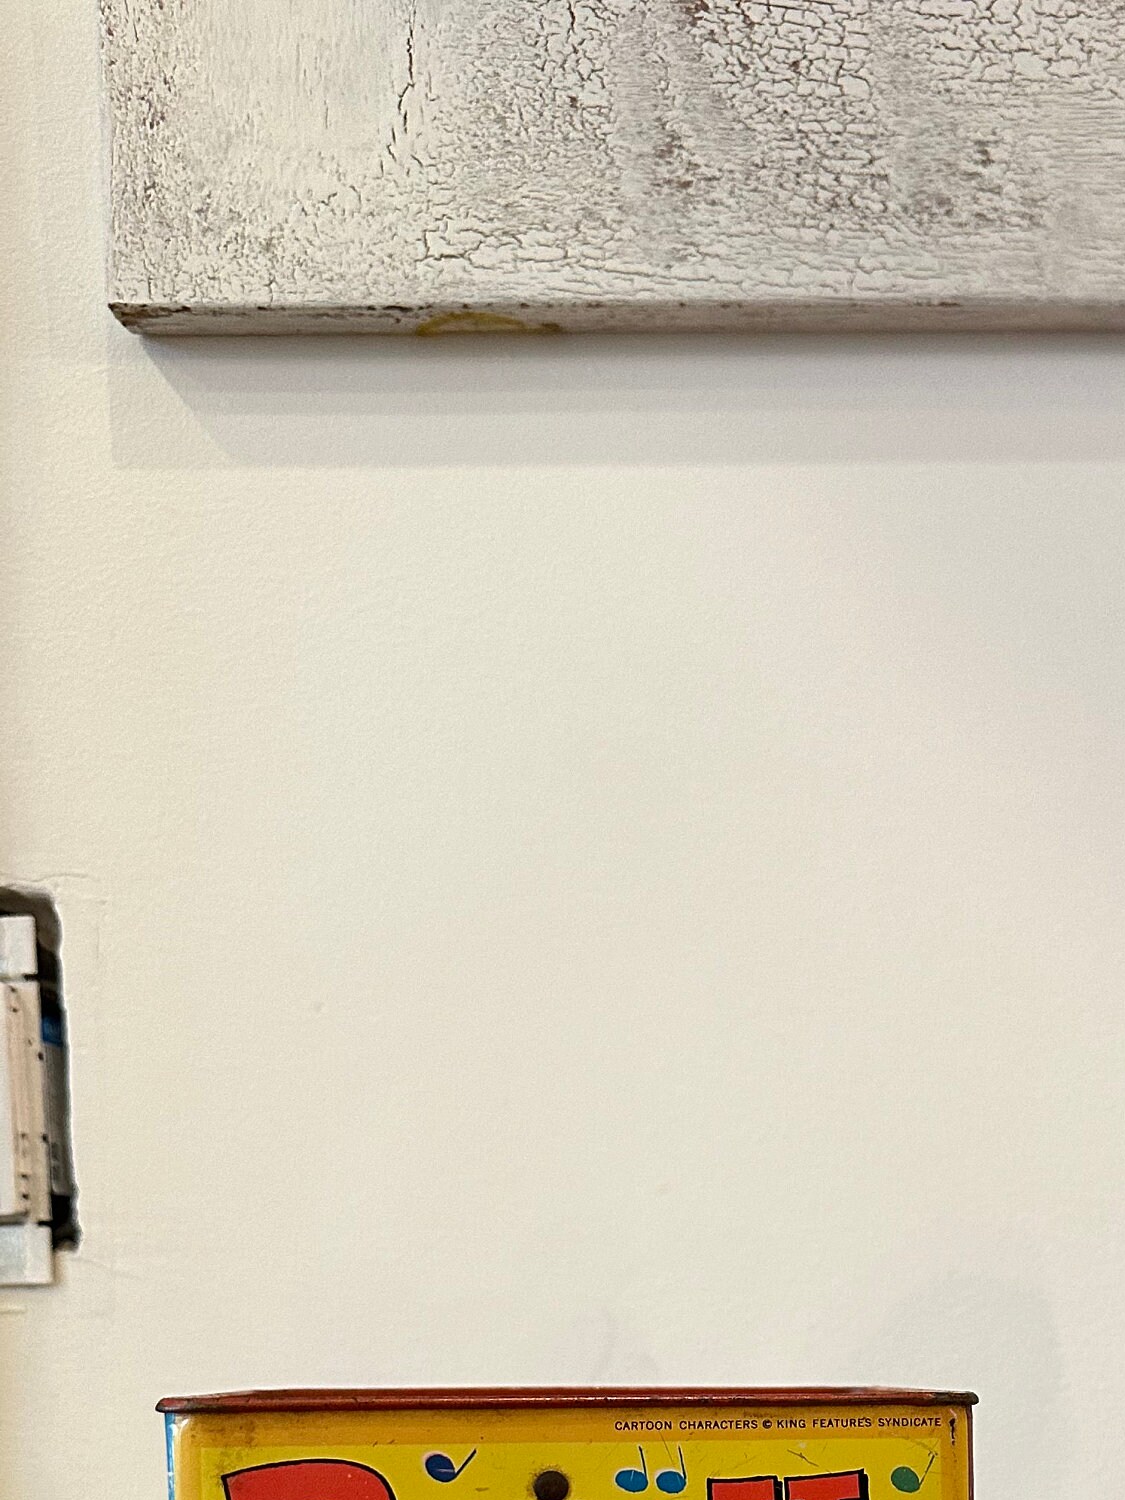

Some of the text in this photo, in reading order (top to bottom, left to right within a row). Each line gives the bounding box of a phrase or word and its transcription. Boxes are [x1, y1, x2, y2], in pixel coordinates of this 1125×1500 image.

[614, 1419, 673, 1431] CARTOON
[679, 1419, 758, 1430] CHARACTERS
[776, 1418, 806, 1429] KING
[812, 1417, 872, 1428] FEATURES
[877, 1416, 942, 1428] SYNDICATE
